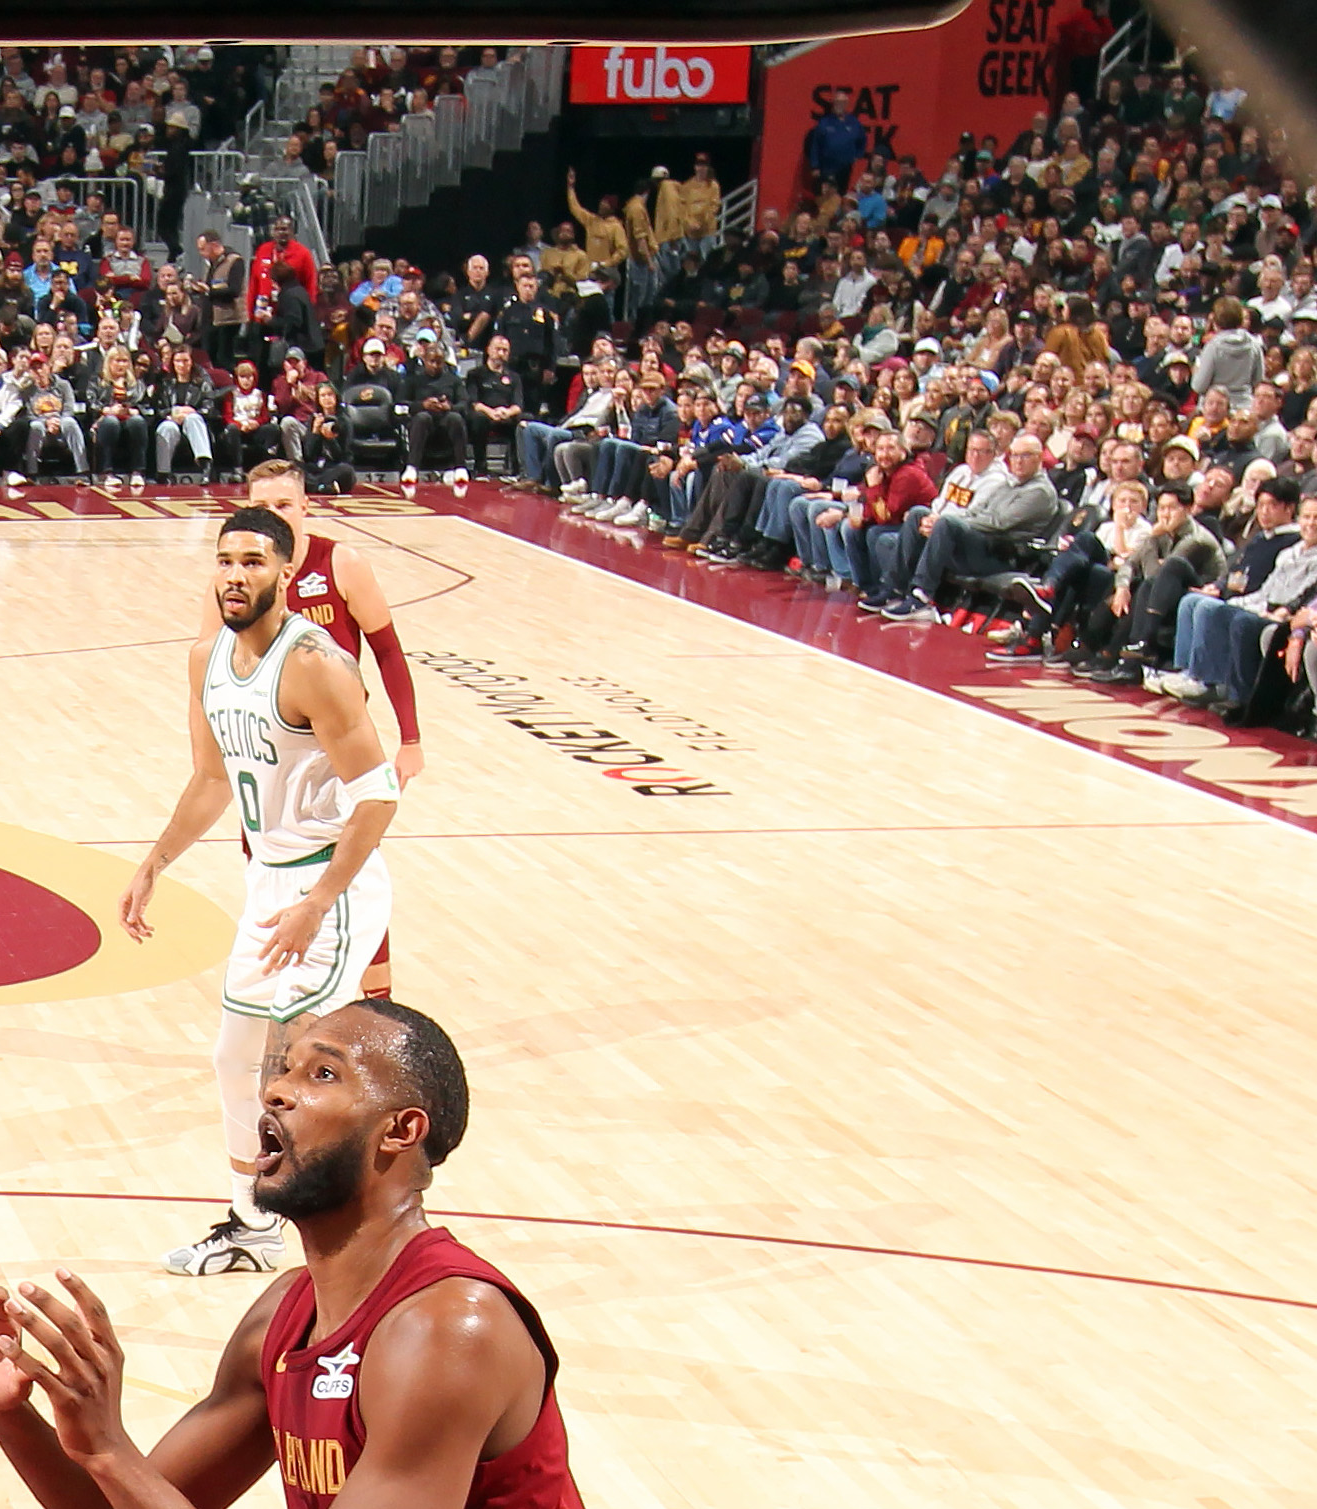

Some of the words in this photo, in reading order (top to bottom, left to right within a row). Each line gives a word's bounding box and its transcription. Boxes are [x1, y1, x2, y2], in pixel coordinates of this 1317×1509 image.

[986, 0, 1054, 43] SEAT
[604, 45, 715, 98] fubo
[977, 50, 1051, 97] GEEK
[237, 770, 262, 832] 0
[316, 1379, 350, 1393] CLIFFS
